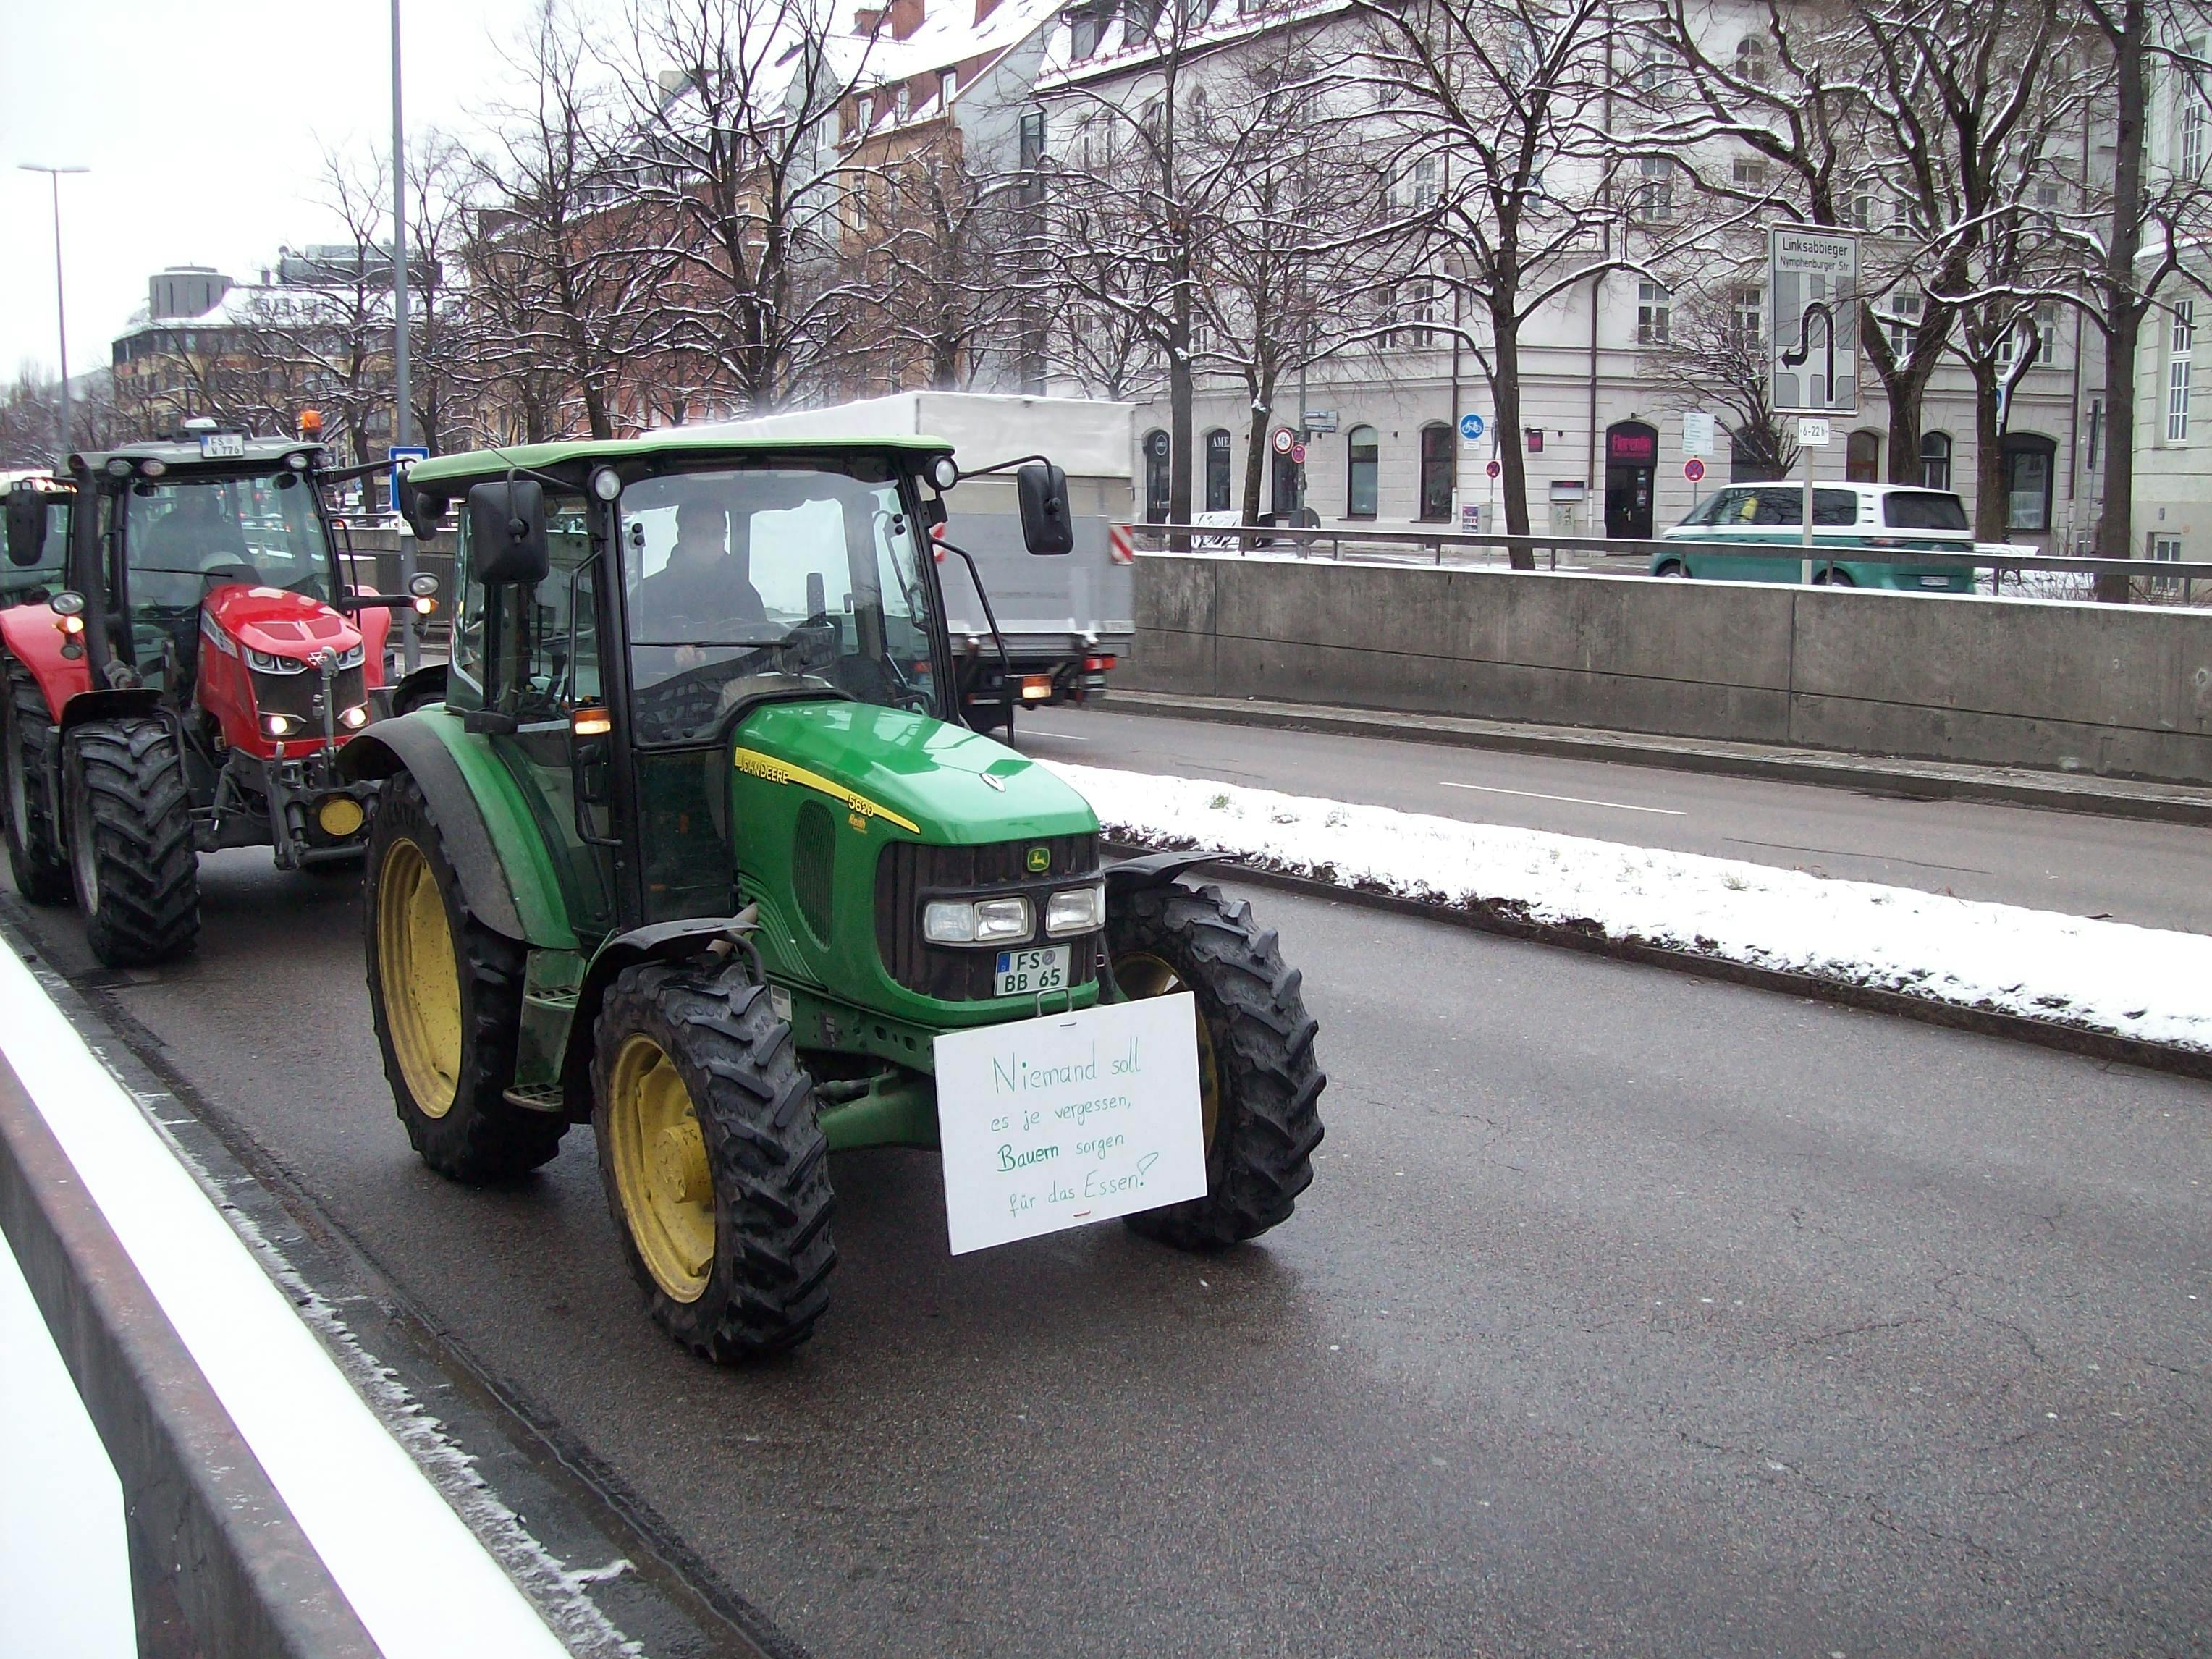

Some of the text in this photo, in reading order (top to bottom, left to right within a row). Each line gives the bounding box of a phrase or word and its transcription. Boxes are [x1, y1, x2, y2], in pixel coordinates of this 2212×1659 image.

[1782, 237, 1849, 259] Linksabbieger
[1780, 255, 1836, 272] Nymphenburger
[211, 437, 224, 446] FS
[221, 445, 240, 455] 776
[848, 795, 874, 817] 5620
[1017, 952, 1040, 971] FS
[1005, 968, 1061, 993] BB 65
[993, 1036, 1141, 1094] Niemand soll
[990, 1094, 1132, 1132] es je vergessen,
[997, 1133, 1125, 1173] Bauern sorgen
[1009, 1192, 1037, 1218] für
[1047, 1181, 1076, 1204] das
